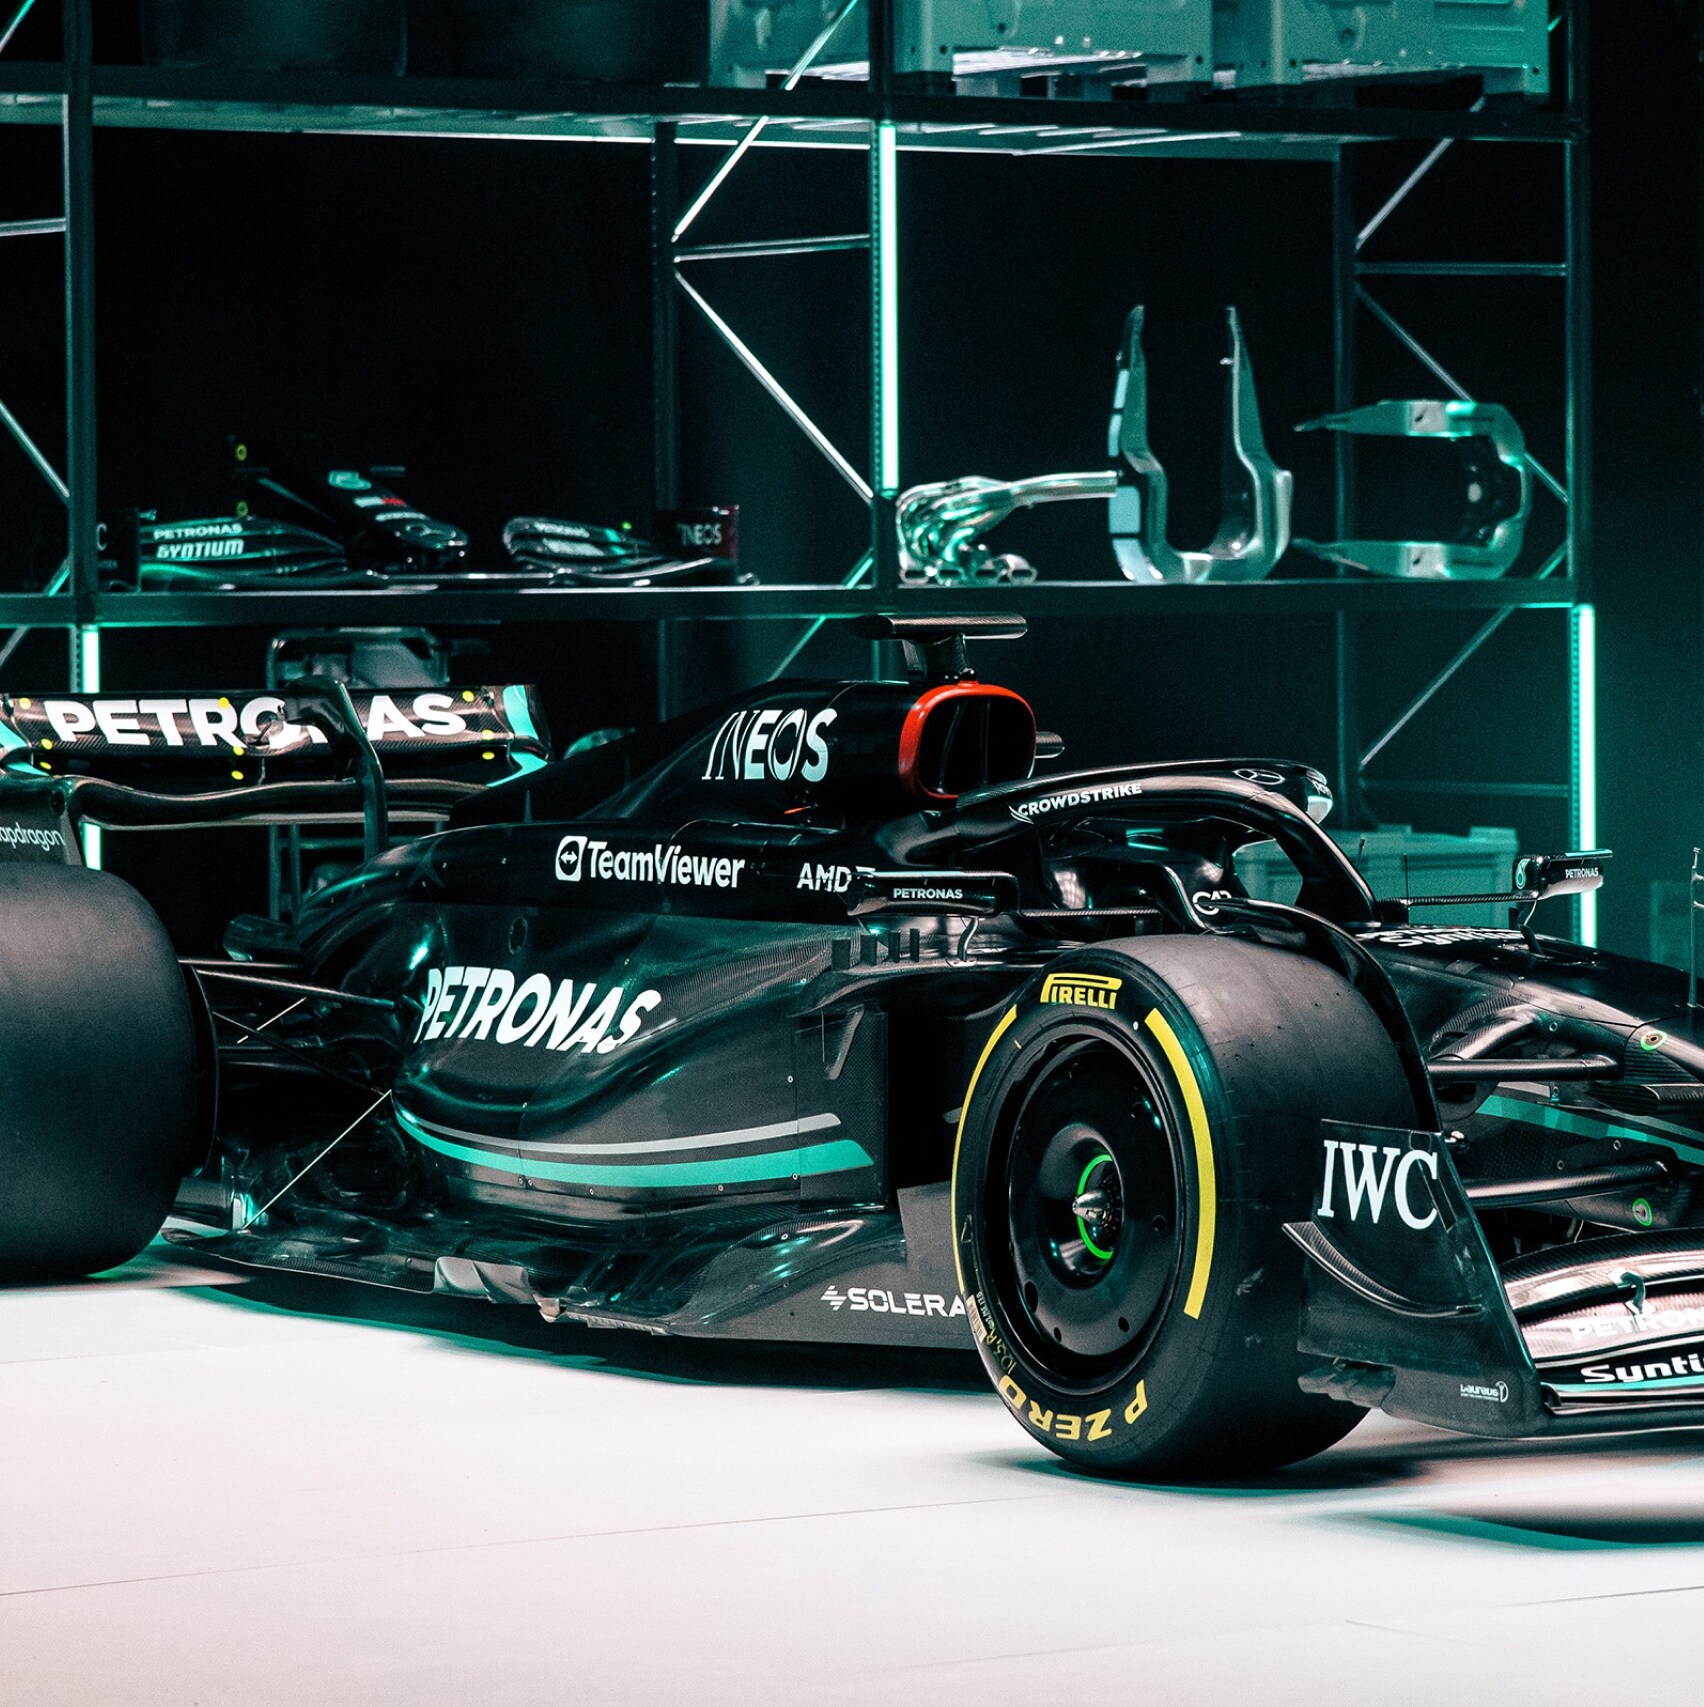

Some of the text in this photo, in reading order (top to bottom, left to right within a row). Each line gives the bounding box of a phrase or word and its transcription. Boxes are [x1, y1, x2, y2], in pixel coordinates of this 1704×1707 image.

[153, 523, 243, 540] PETRONAS
[43, 692, 468, 750] PETROAS
[701, 707, 838, 783] INEOS
[1017, 783, 1143, 817] CROWDSTRIKE
[0, 820, 67, 852] apdragon
[587, 840, 746, 888] TeamViewer
[796, 862, 852, 893] AMD
[1565, 866, 1600, 880] PETRONAS
[893, 887, 964, 900] PETRONAS
[1040, 972, 1123, 1010] PIRELLI
[413, 965, 662, 1055] PETRONAS
[1317, 1139, 1439, 1231] IWC
[847, 1286, 967, 1318] SOLERA
[1580, 1352, 1704, 1384] Synti
[998, 1374, 1149, 1441] P ZERO
